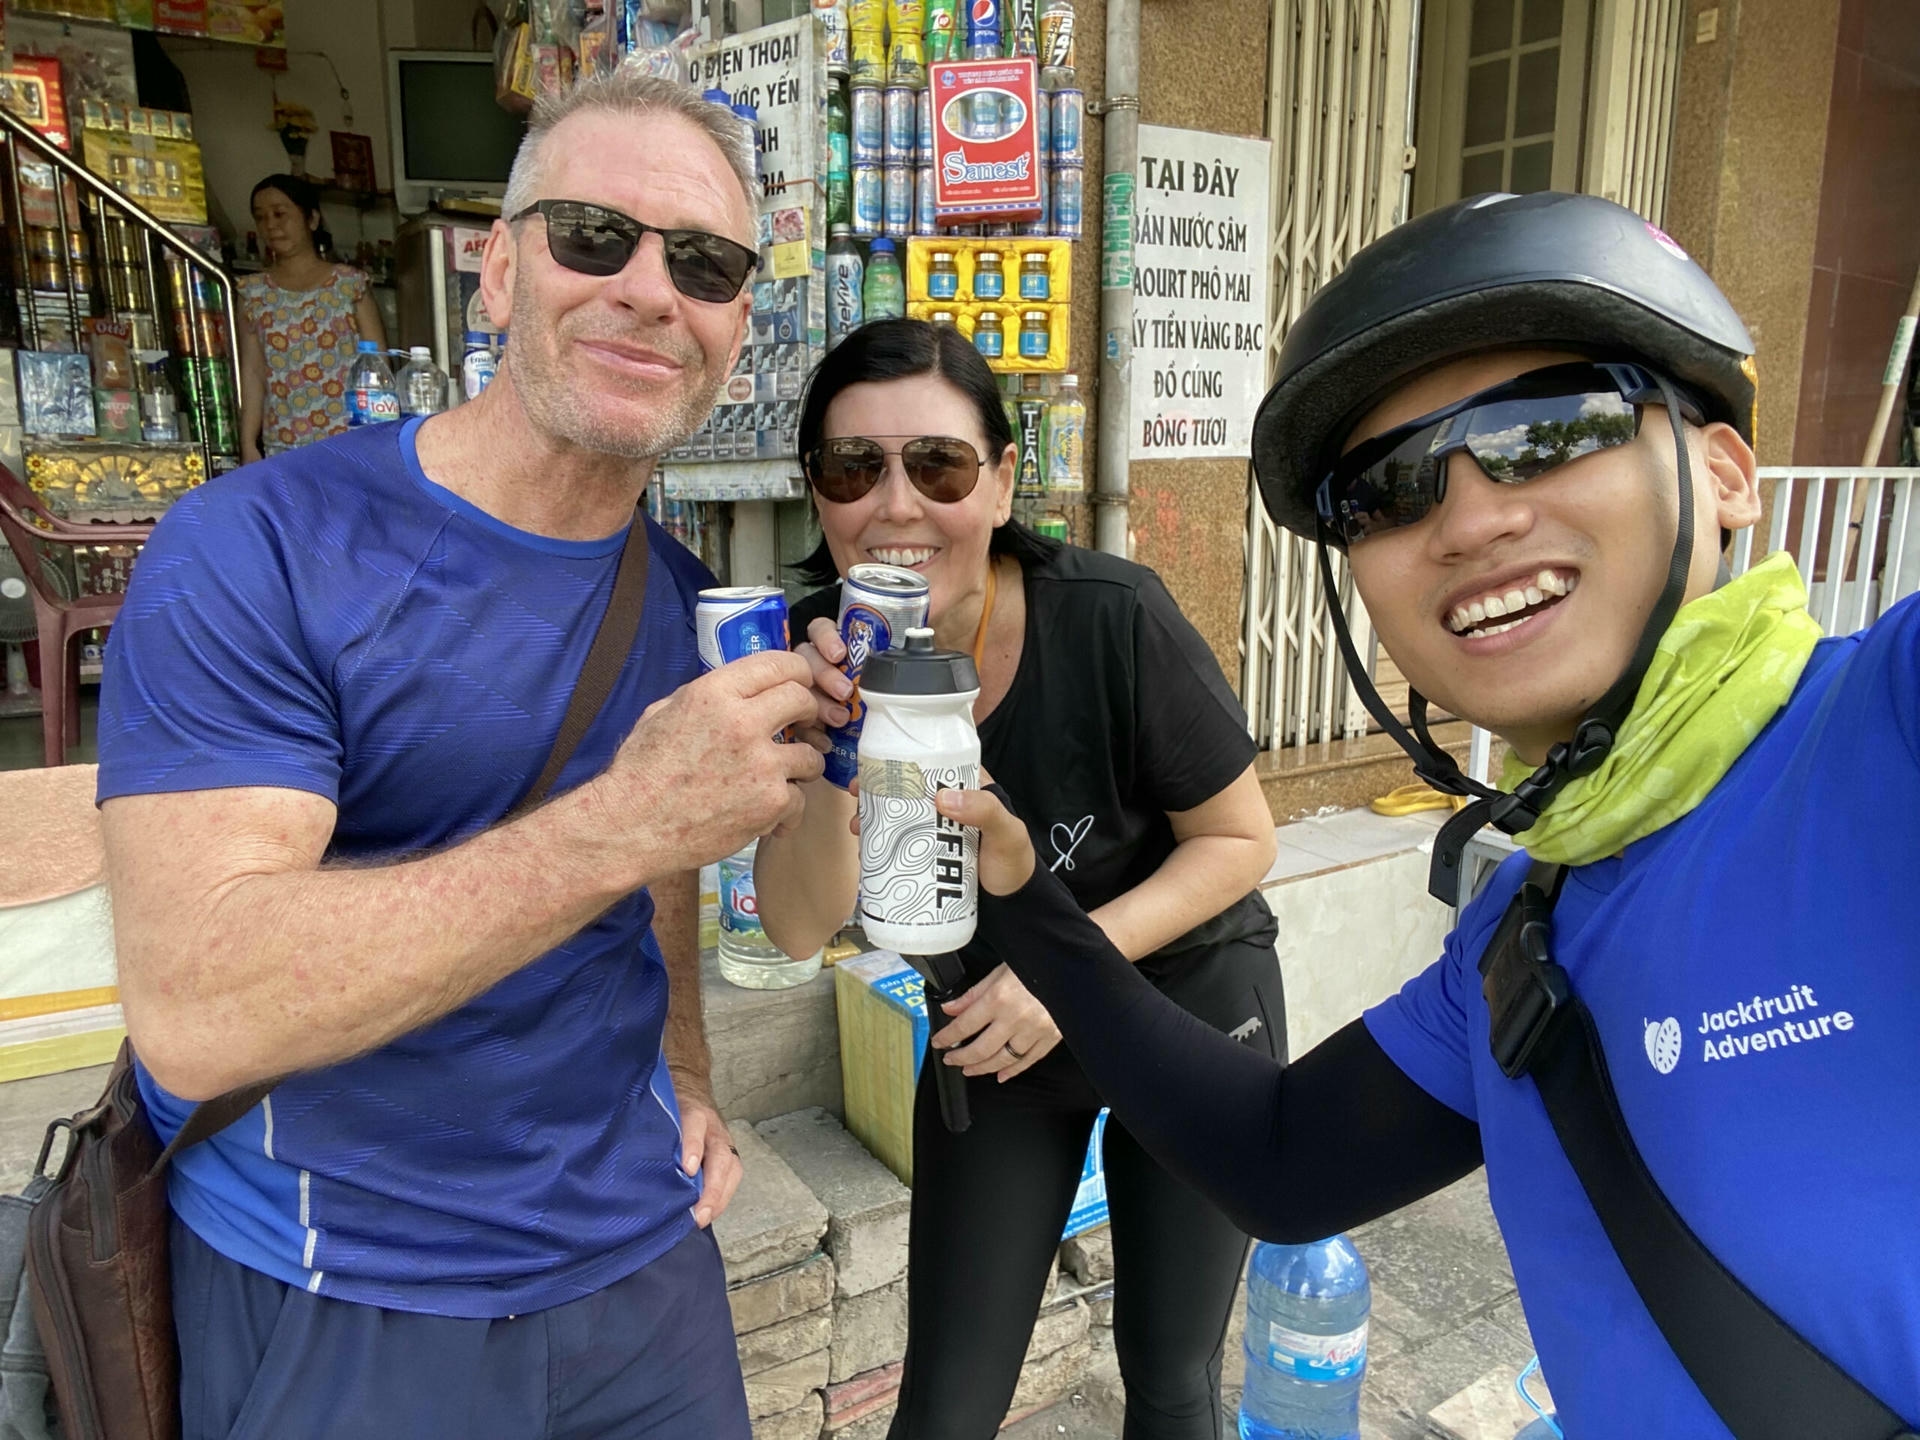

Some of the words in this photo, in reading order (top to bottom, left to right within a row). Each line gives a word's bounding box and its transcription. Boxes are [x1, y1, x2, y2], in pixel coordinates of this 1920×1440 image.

[749, 33, 800, 69] THOẠI
[766, 70, 800, 107] YẾN
[943, 146, 1029, 185] Sanest
[1140, 156, 1185, 198] TẠI
[1192, 158, 1240, 198] ĐÂY
[1169, 211, 1215, 250] NƯỚC
[1218, 215, 1247, 253] SÂM
[1191, 264, 1221, 301] PHÔ
[1225, 272, 1251, 303] MAI
[1151, 309, 1187, 350] TIỀN
[1191, 314, 1231, 350] VÀNG
[1234, 322, 1263, 358] BẠC
[1153, 360, 1177, 399] ĐỒ
[1182, 363, 1223, 399] CÚNG
[1142, 412, 1188, 448] BÔNG
[1191, 416, 1228, 447] TƯƠI
[1698, 984, 1818, 1034] Jackfruit
[1703, 1011, 1854, 1062] Adventure
